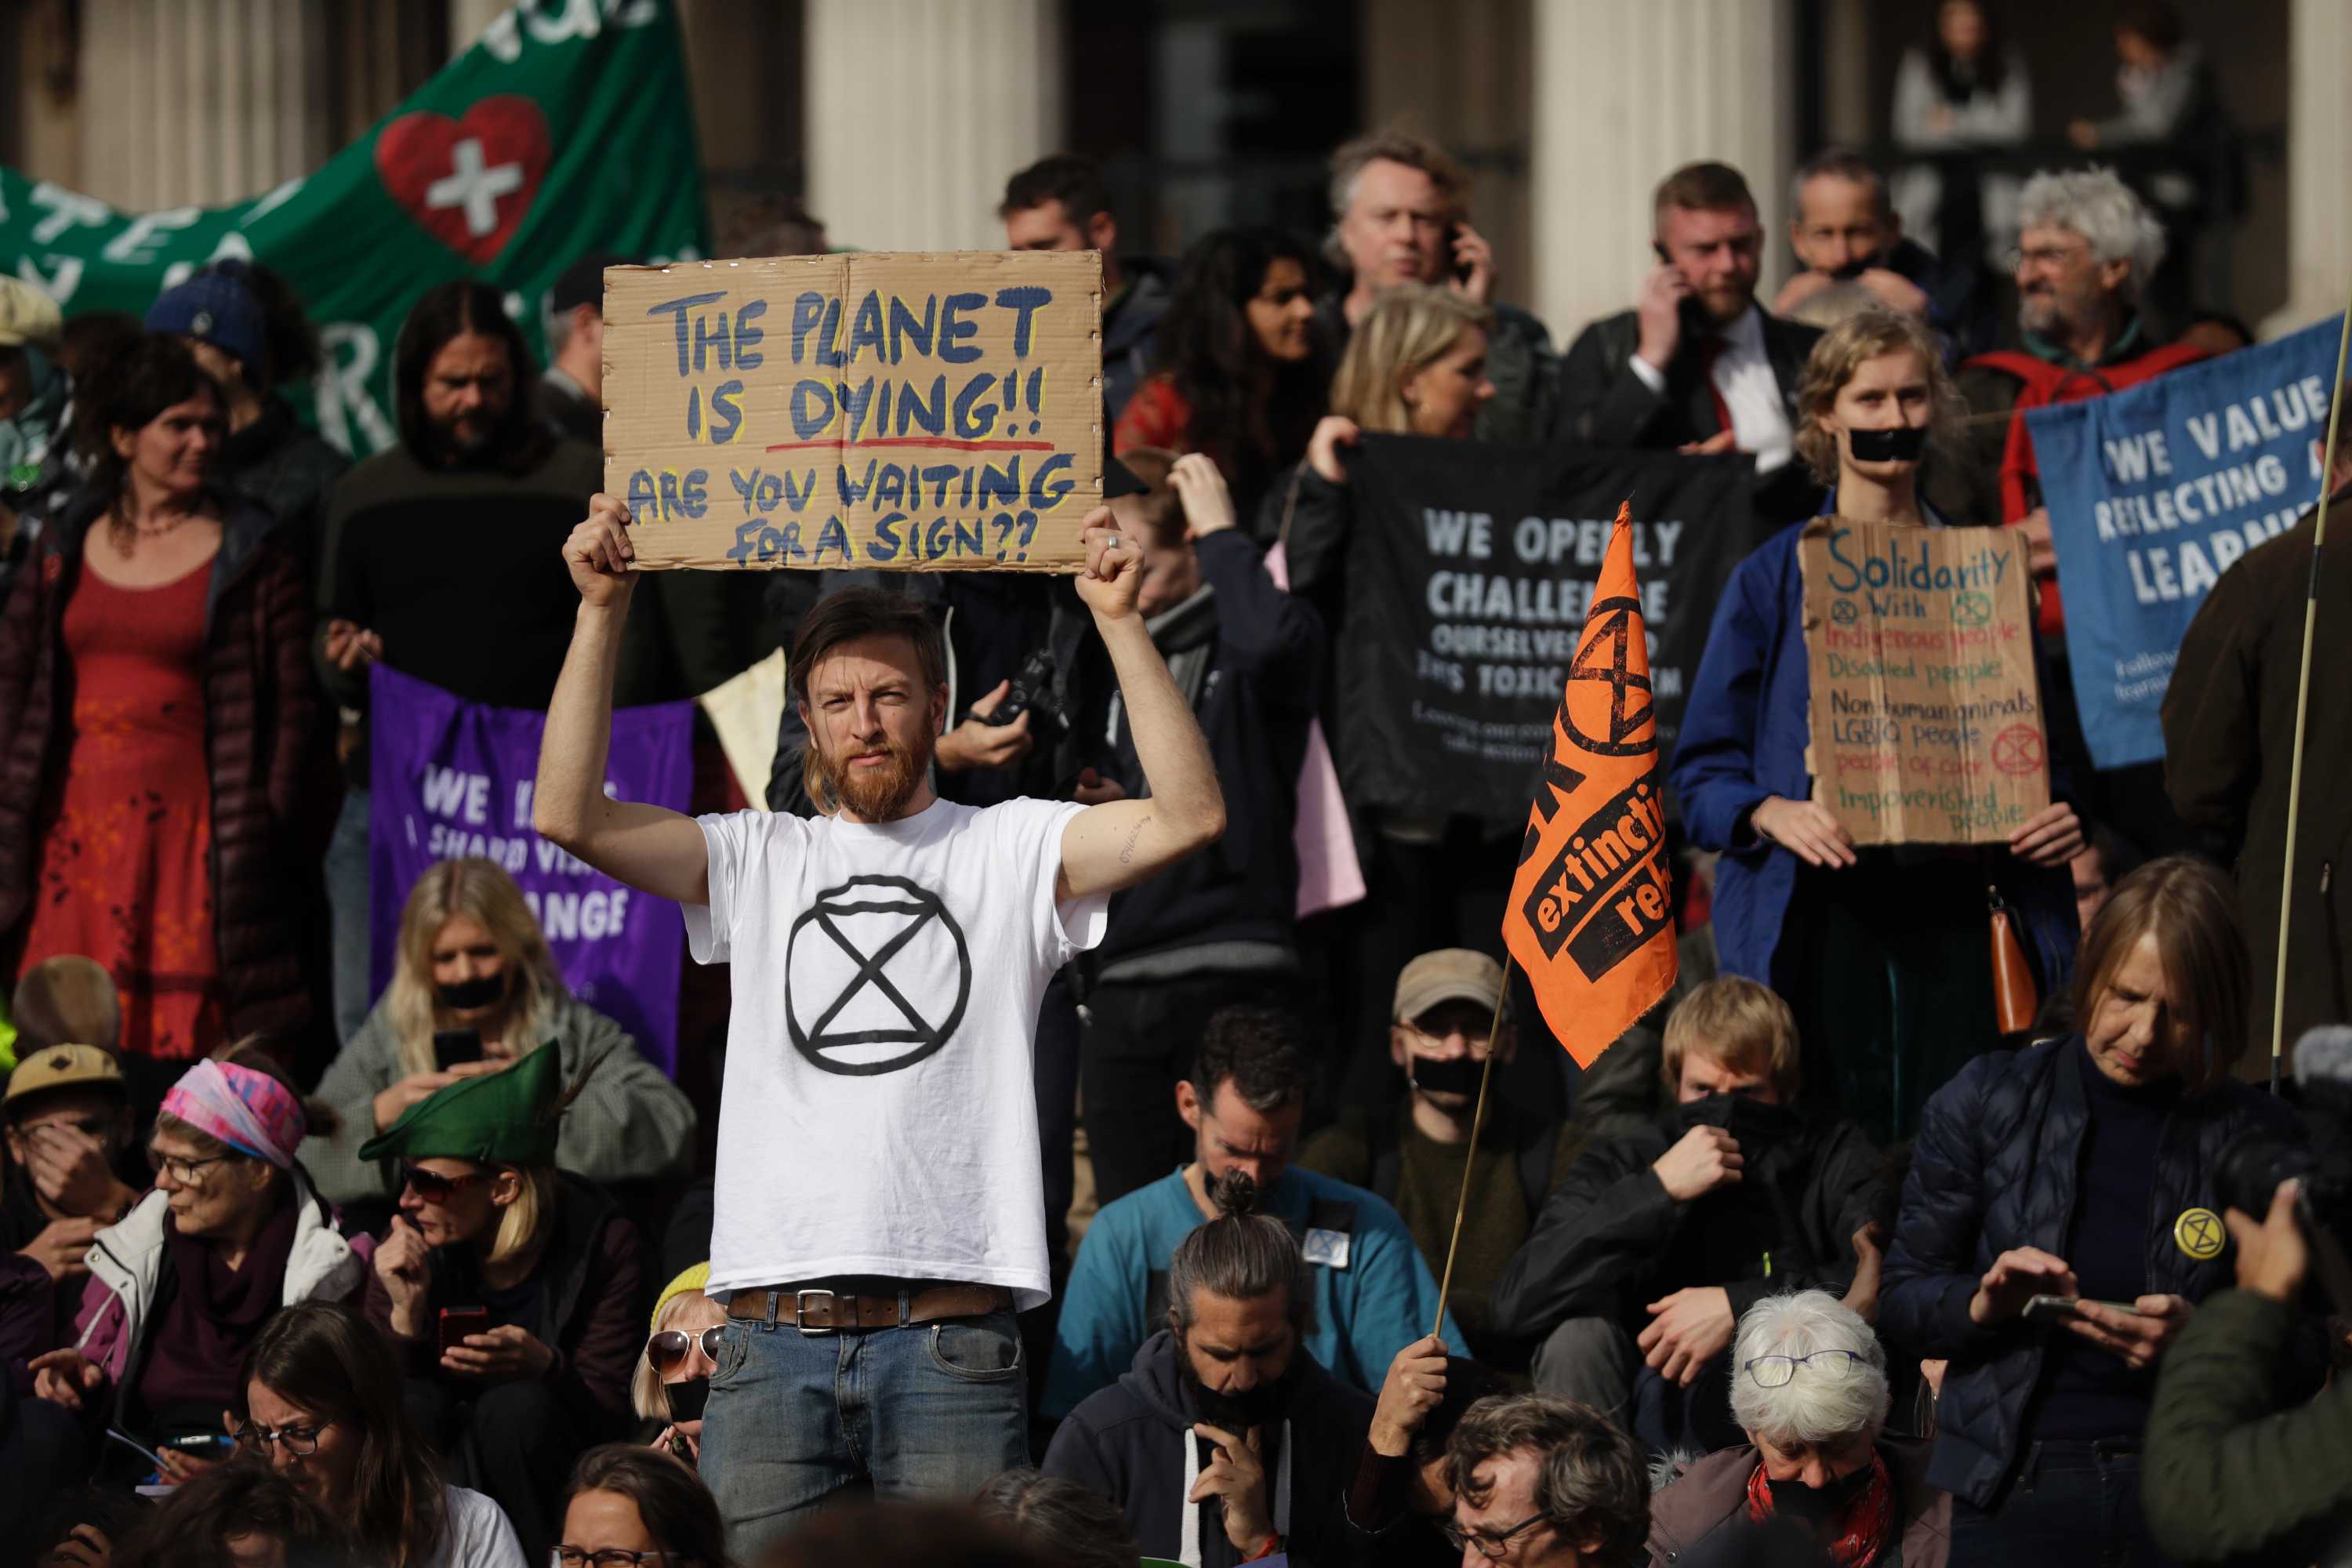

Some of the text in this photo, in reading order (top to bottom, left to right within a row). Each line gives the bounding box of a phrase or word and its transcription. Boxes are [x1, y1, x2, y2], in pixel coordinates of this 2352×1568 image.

[648, 287, 1052, 377] THE PLANET
[688, 366, 1046, 445] IS DYING!!
[2104, 430, 2172, 484] WE
[2186, 375, 2329, 460] VALUE
[627, 453, 1076, 526] ARE YOU WAITING
[726, 510, 1040, 567] FOR A SIGN??
[1422, 507, 1493, 559] WE
[1828, 528, 2010, 593] Solidarity
[1427, 570, 1670, 623] CHALLEE
[423, 764, 491, 825] WE
[1537, 784, 1664, 932] extincti
